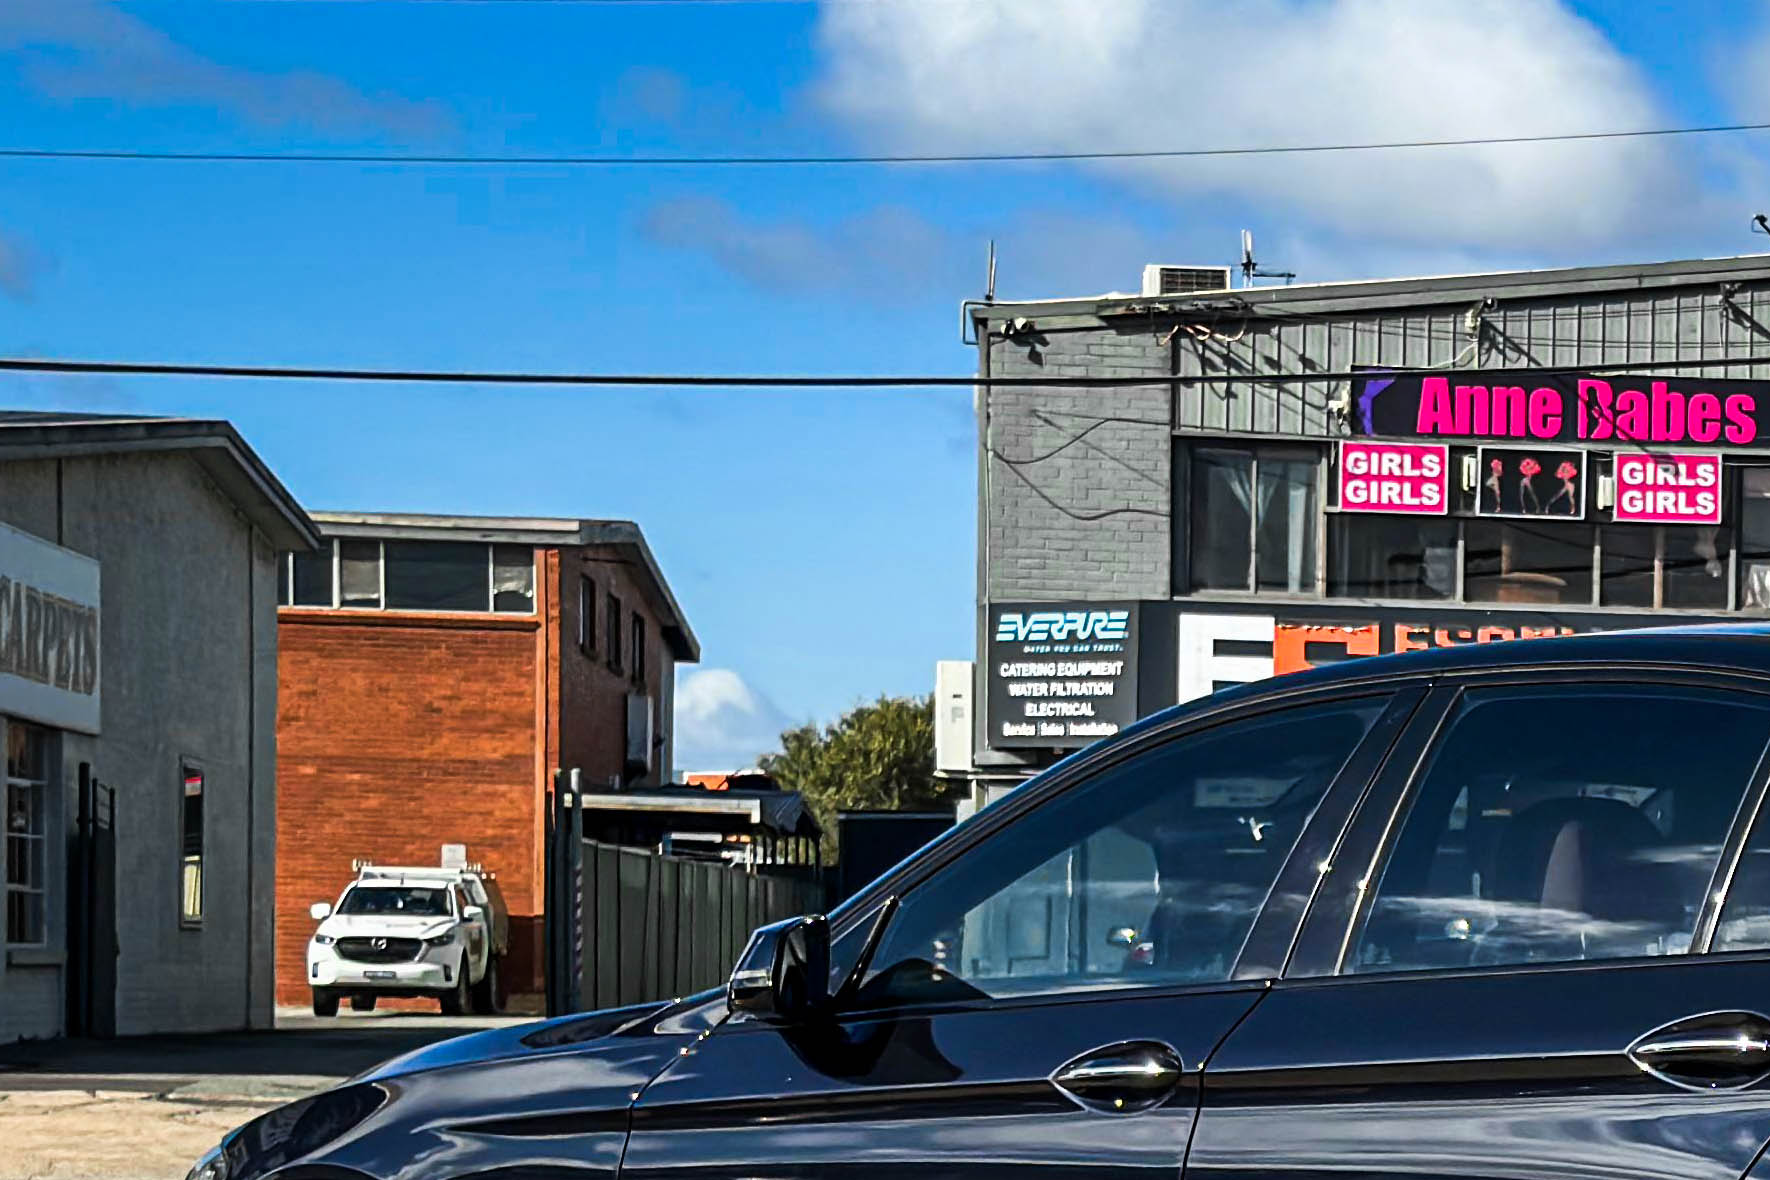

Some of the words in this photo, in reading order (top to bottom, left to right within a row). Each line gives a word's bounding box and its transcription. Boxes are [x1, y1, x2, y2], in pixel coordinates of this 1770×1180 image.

[1416, 377, 1562, 439] Anne
[1577, 378, 1757, 444] Babes
[1345, 450, 1441, 478] GIRLS
[1621, 461, 1716, 487] GIRLS
[1345, 479, 1441, 507] GIRLS
[1621, 489, 1716, 515] GIRLS
[996, 611, 1129, 641] EVERPURE
[1000, 662, 1056, 677] CATERING
[1057, 661, 1123, 676] EQUIPMENT
[1008, 682, 1048, 696] WATER
[1050, 682, 1113, 696] FILTRATION
[1025, 702, 1095, 716] ELECTRICAL
